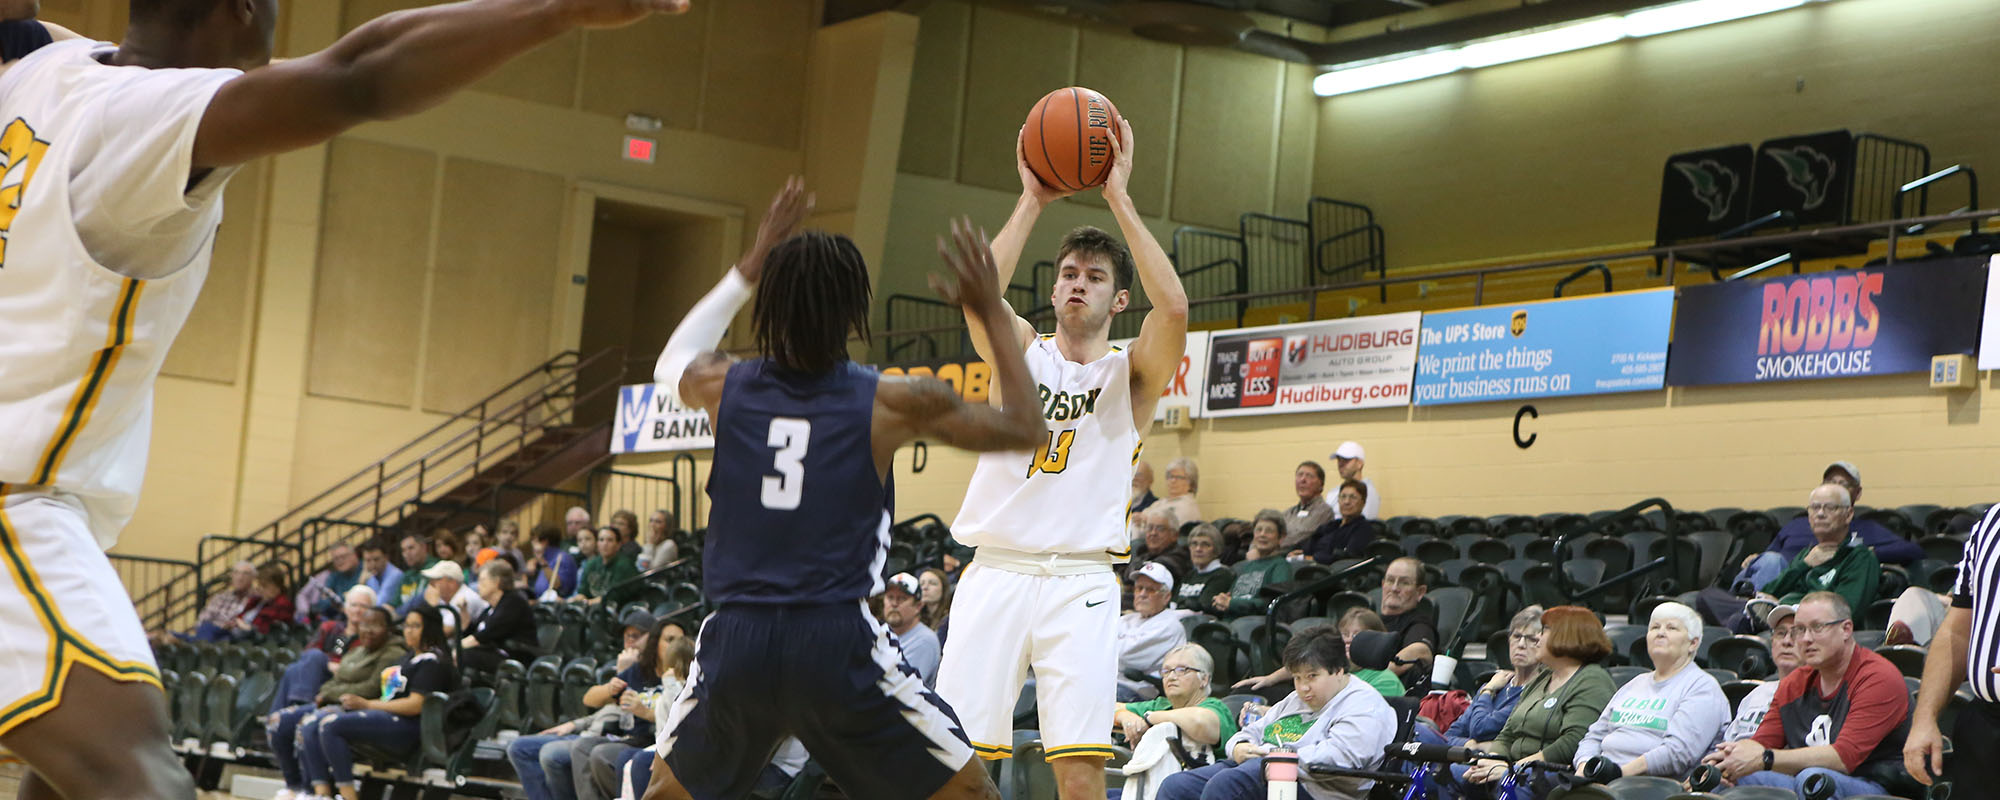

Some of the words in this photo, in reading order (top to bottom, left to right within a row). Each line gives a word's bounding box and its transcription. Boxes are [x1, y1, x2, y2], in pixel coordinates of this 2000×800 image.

[1087, 95, 1108, 128] ROCK
[1089, 136, 1107, 167] THE
[1757, 271, 1884, 355] ROBB'S
[1312, 329, 1414, 353] HUDIBURG
[1421, 328, 1442, 346] The
[1445, 324, 1470, 343] UPS
[1472, 322, 1506, 341] Store
[1328, 357, 1355, 366] AUTO
[1357, 355, 1393, 364] GROUP
[1419, 354, 1440, 376] We
[1441, 352, 1476, 379] print
[1479, 349, 1503, 371] the
[1506, 346, 1552, 371] things
[1755, 350, 1872, 380] SMOKEHOUSE
[1210, 382, 1238, 399] MORE
[1244, 376, 1272, 396] LESS
[1280, 384, 1408, 404] Hudiburg.com
[1415, 382, 1447, 406] your
[1449, 376, 1511, 398] business
[1513, 375, 1548, 394] runs
[1550, 373, 1571, 392] on
[653, 417, 712, 439] BANK
[1513, 404, 1538, 450] C
[761, 416, 811, 511] 3
[912, 441, 928, 473] D
